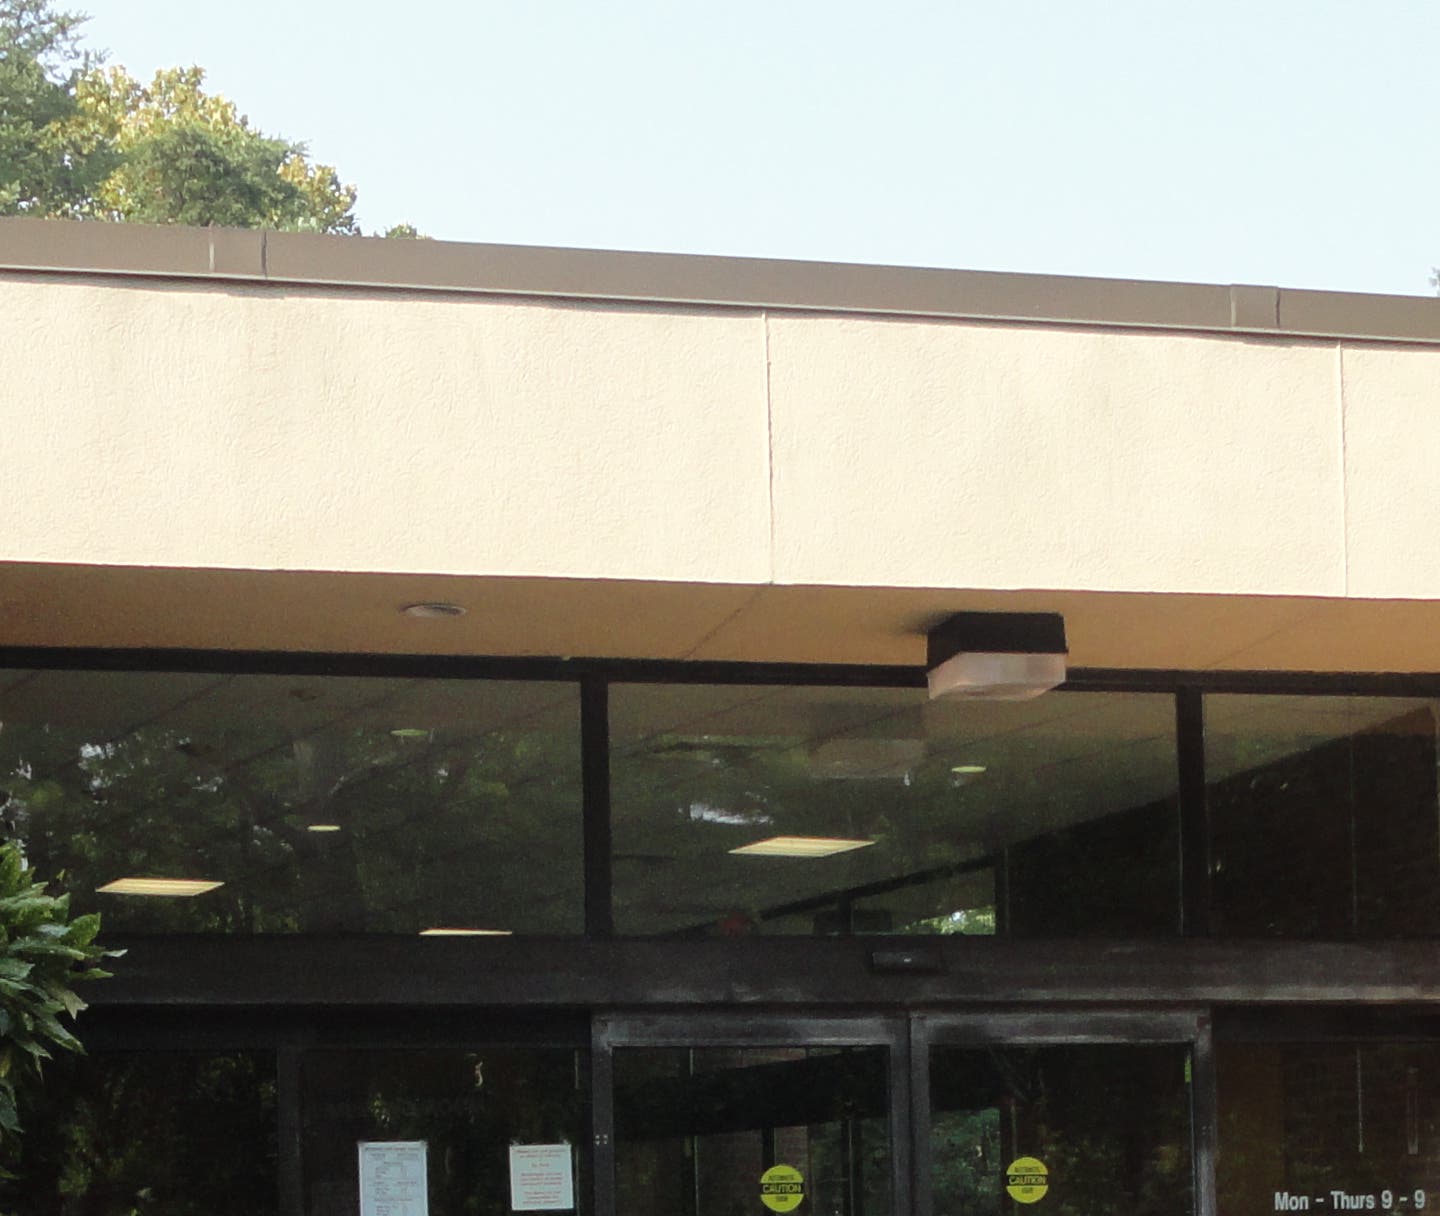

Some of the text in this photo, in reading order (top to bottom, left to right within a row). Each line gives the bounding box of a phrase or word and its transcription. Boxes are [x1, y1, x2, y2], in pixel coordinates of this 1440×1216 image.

[762, 1183, 803, 1194] CAUTION
[1273, 1191, 1310, 1211] Mon
[1330, 1190, 1376, 1210] Thurs
[1380, 1189, 1393, 1209] 9
[1413, 1189, 1426, 1209] 9
